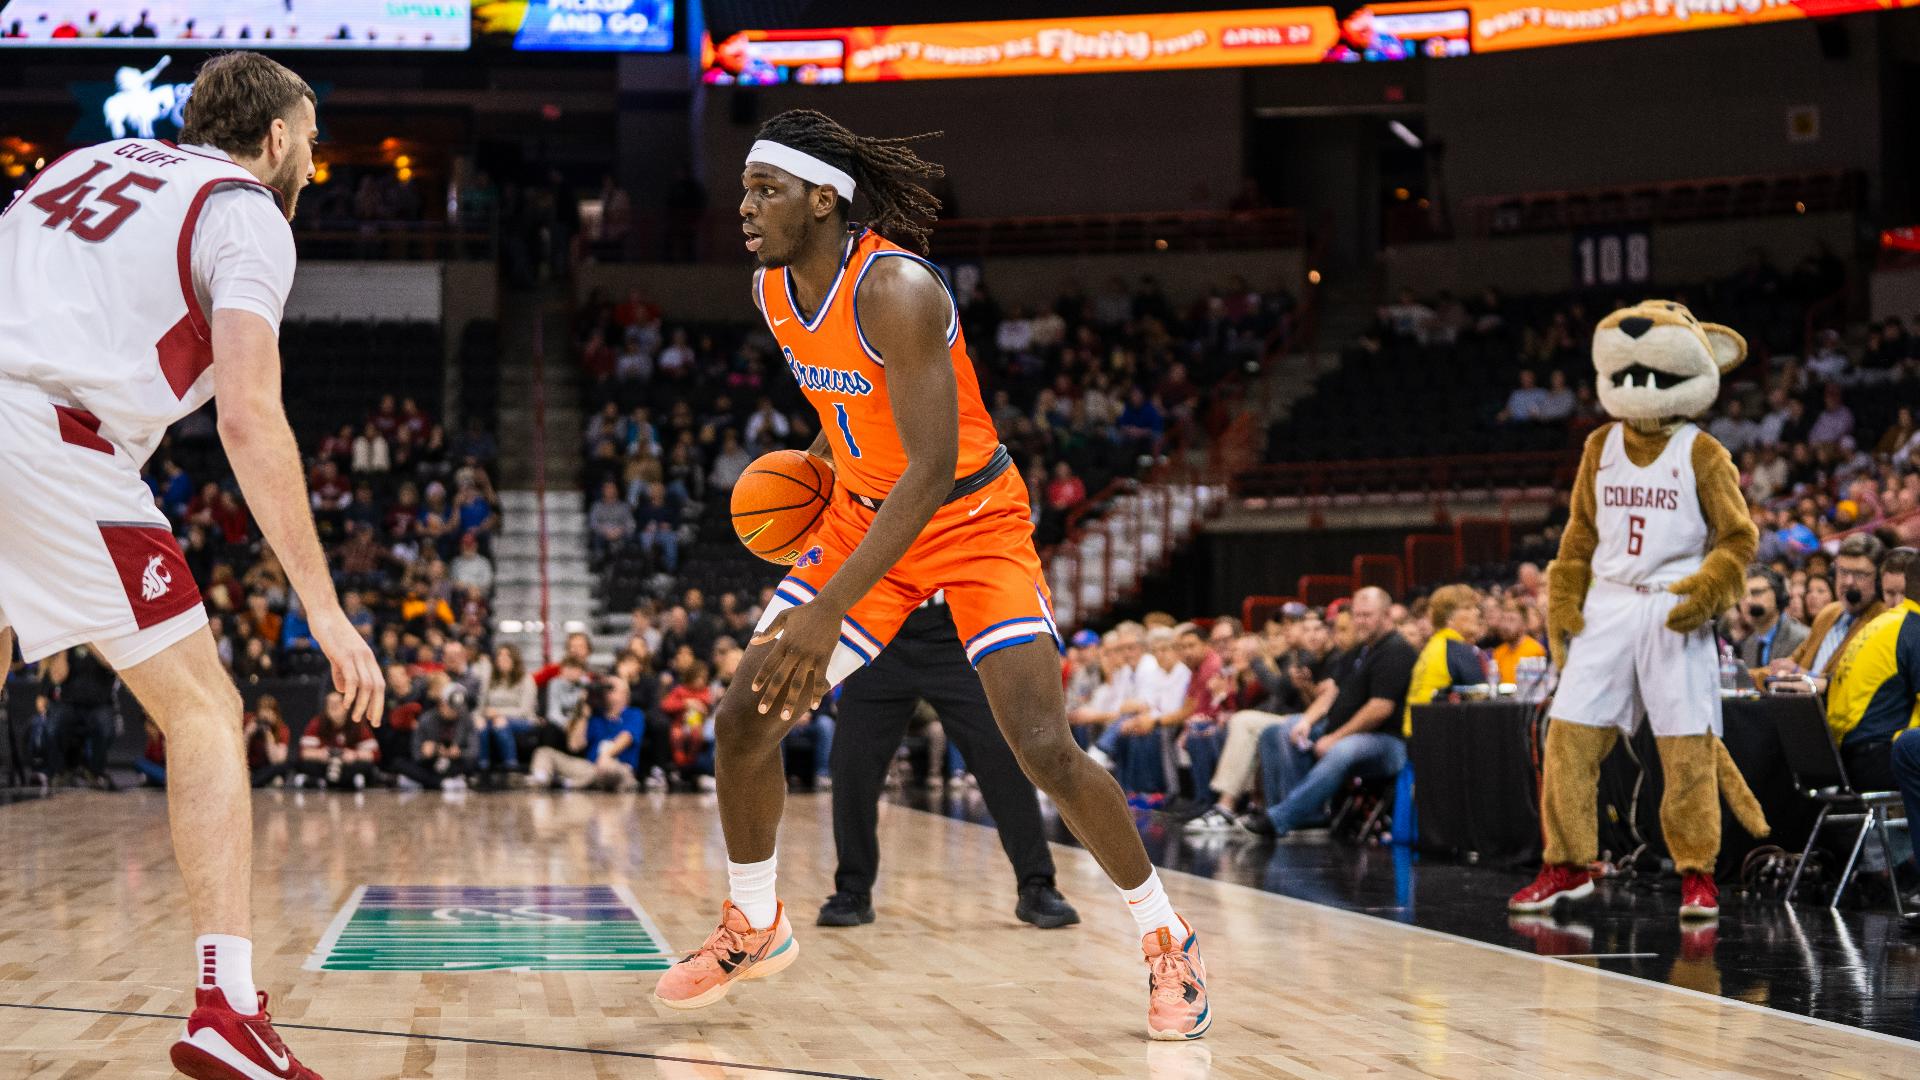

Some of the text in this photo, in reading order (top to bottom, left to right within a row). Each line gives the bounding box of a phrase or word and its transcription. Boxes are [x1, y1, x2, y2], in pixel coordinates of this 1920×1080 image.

[547, 12, 649, 33] AND GO
[1223, 27, 1281, 45] APRIL
[113, 142, 187, 169] CLUFF
[30, 159, 168, 243] 45
[832, 402, 862, 458] 1
[1603, 485, 1679, 511] COUGARS
[1627, 514, 1646, 556] 6
